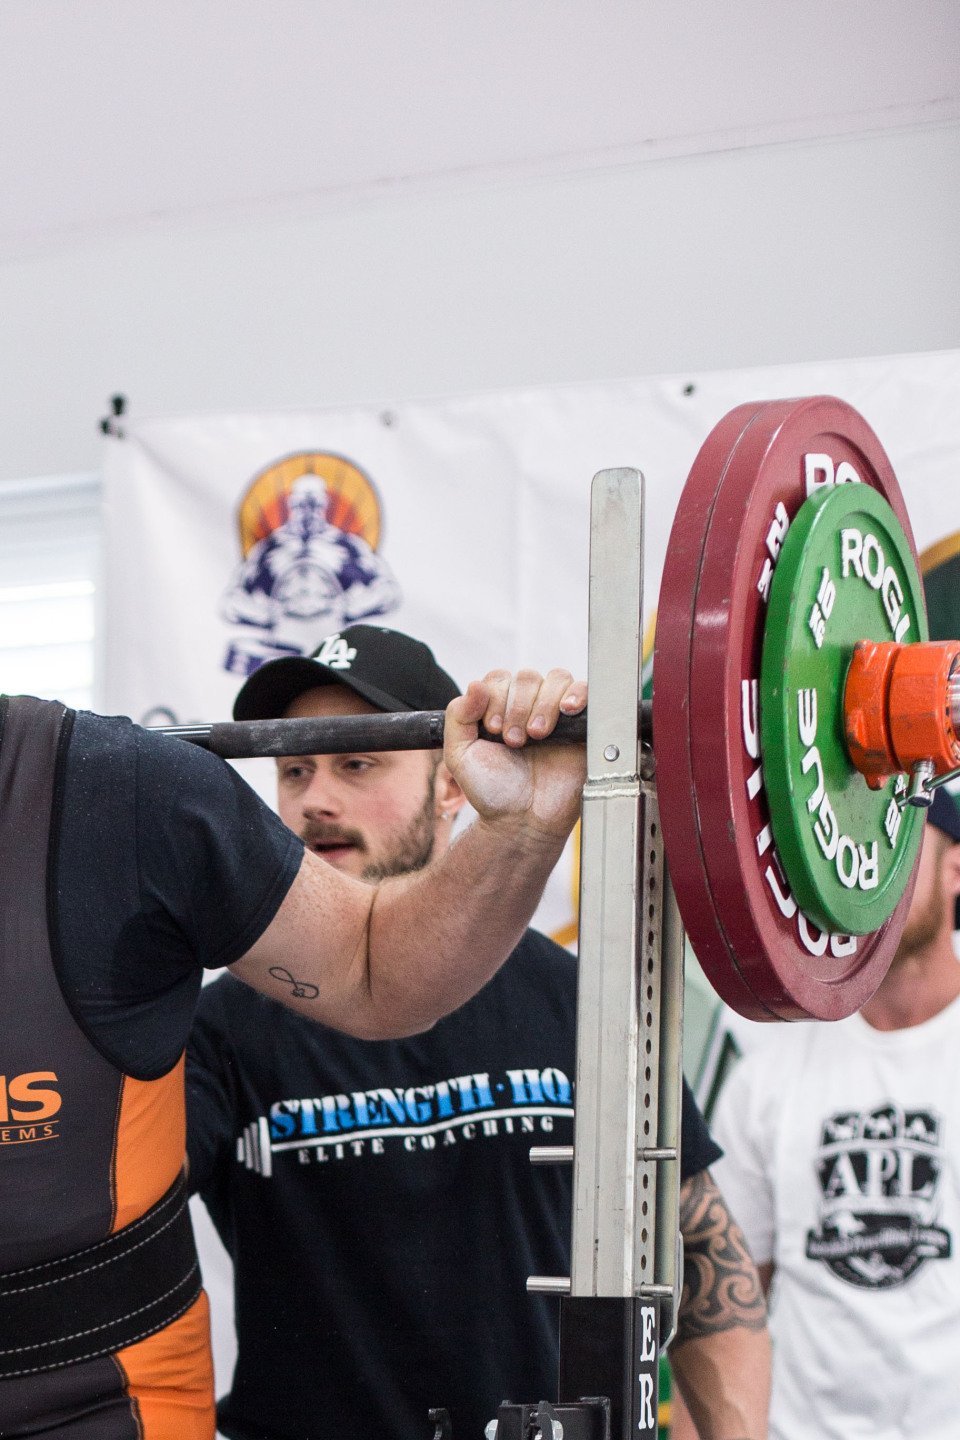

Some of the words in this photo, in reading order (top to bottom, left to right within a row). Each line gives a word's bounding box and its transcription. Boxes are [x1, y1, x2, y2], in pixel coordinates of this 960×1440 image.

[841, 528, 911, 643] ROG
[313, 633, 357, 669] LA
[797, 687, 879, 891] ROGUE
[298, 1139, 385, 1165] ELITE
[403, 1116, 555, 1153] COACHING
[825, 1151, 934, 1198] APL
[638, 1306, 656, 1430] ER
